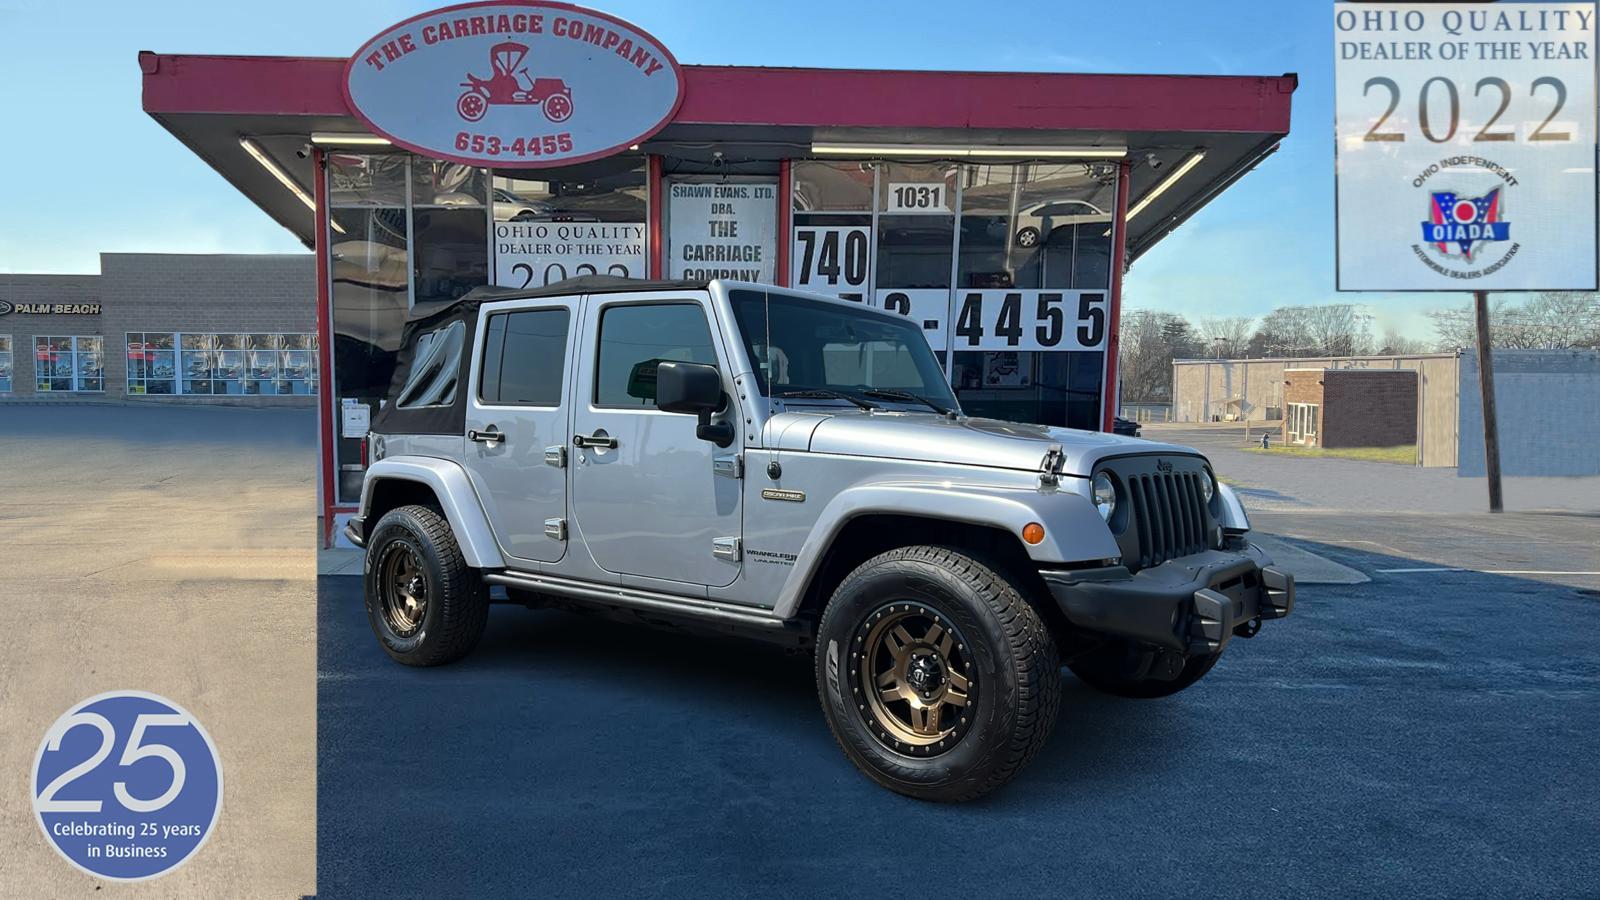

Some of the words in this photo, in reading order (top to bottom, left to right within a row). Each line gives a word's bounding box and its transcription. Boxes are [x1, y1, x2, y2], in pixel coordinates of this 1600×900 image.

[1336, 10, 1425, 32] OHIO
[1442, 10, 1592, 36] QUALITY
[365, 33, 416, 71] THE
[422, 14, 544, 46] CARRIAGE
[552, 16, 664, 77] COMPANY
[1340, 42, 1433, 60] DEALER
[1439, 42, 1470, 60] OF
[1475, 42, 1521, 60] THE
[1528, 42, 1589, 60] YEAR
[1362, 76, 1571, 143] 2022
[455, 131, 573, 157] 653-4455
[1412, 164, 1439, 188] OHIO
[1440, 156, 1519, 188] INDEPENDENT
[672, 186, 712, 198] SHAWN
[754, 187, 775, 199] LTD.
[895, 187, 940, 208] 1031
[711, 203, 736, 215] DBA.
[497, 226, 548, 239] OHIO
[557, 226, 644, 241] QUALITY
[708, 220, 738, 238] THE
[1432, 224, 1495, 241] OIADA
[500, 243, 552, 254] DEALER
[555, 244, 573, 254] OF
[576, 244, 603, 255] THE
[607, 244, 642, 255] YEAR
[683, 244, 762, 262] CARRIAGE
[797, 230, 868, 286] 740
[683, 269, 761, 283] COMPANY
[14, 303, 51, 313] PALM
[54, 304, 100, 314] BEACH
[746, 549, 789, 558] WRANGLER
